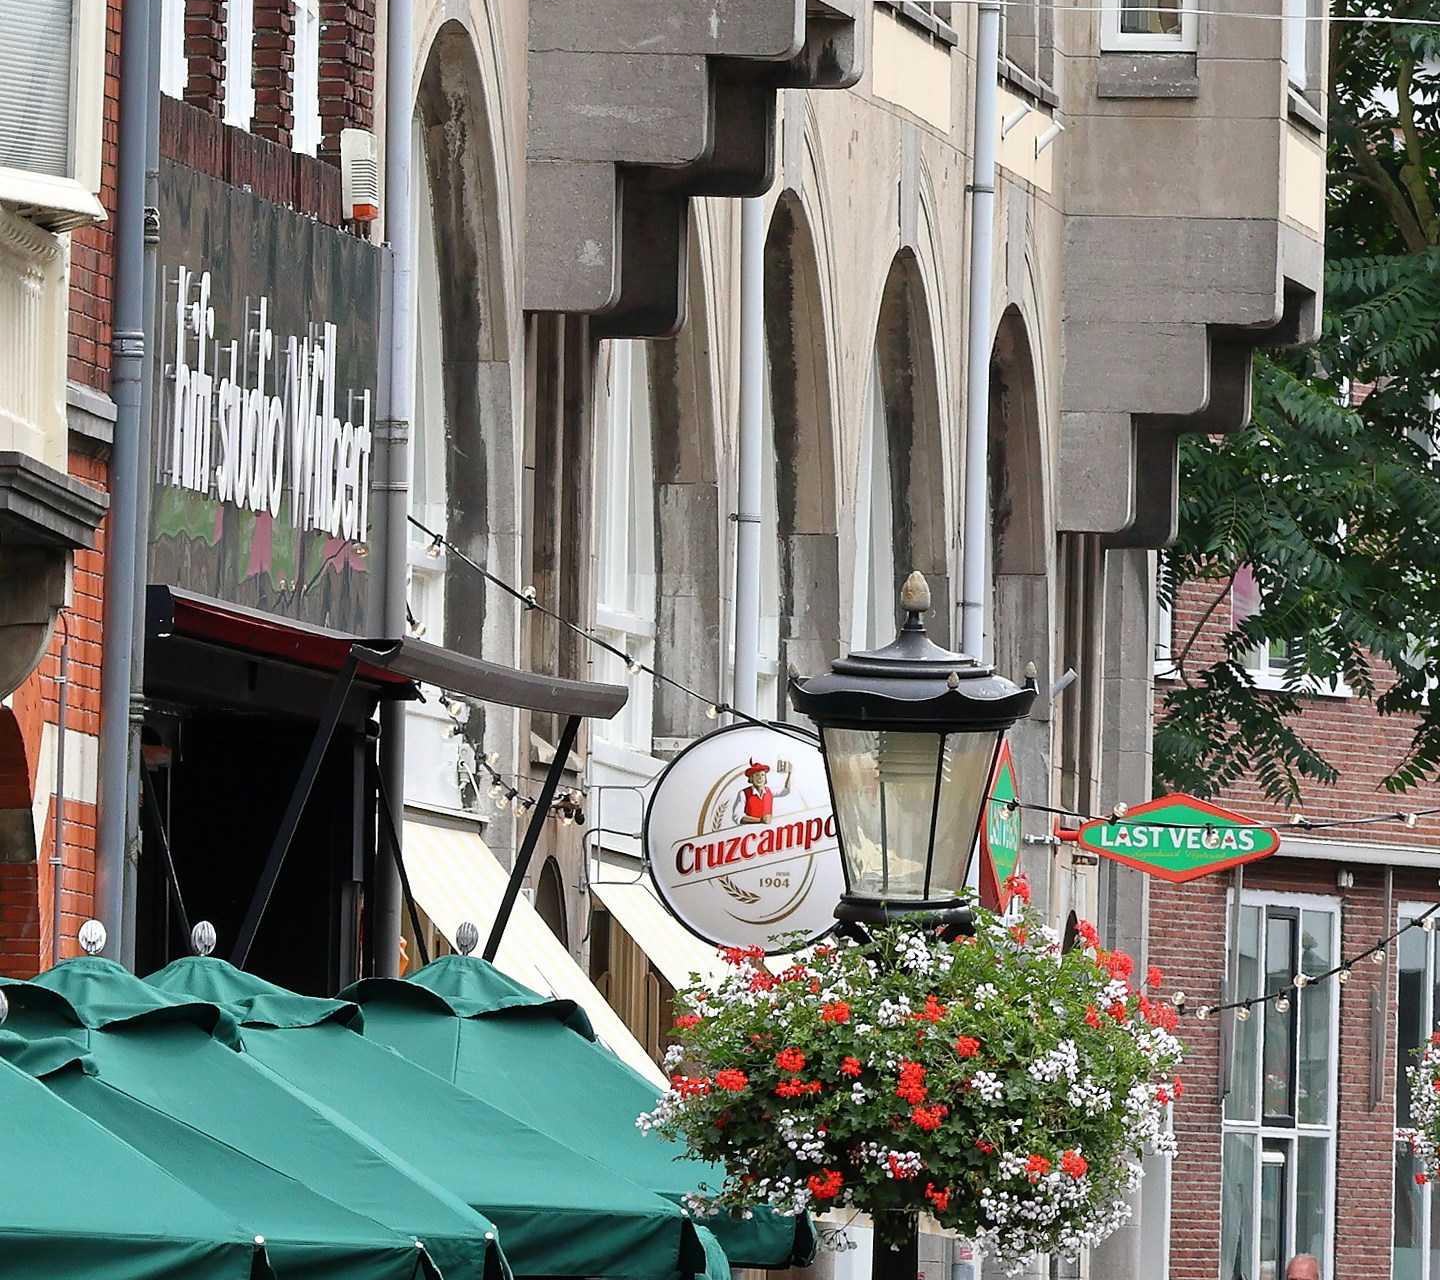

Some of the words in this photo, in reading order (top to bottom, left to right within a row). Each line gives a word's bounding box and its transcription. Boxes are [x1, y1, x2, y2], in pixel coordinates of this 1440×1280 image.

[217, 297, 285, 520] studio
[285, 321, 372, 543] Wilbert
[1101, 826, 1164, 848] LAST
[1168, 827, 1255, 851] VEGAS
[758, 877, 790, 889] 1904
